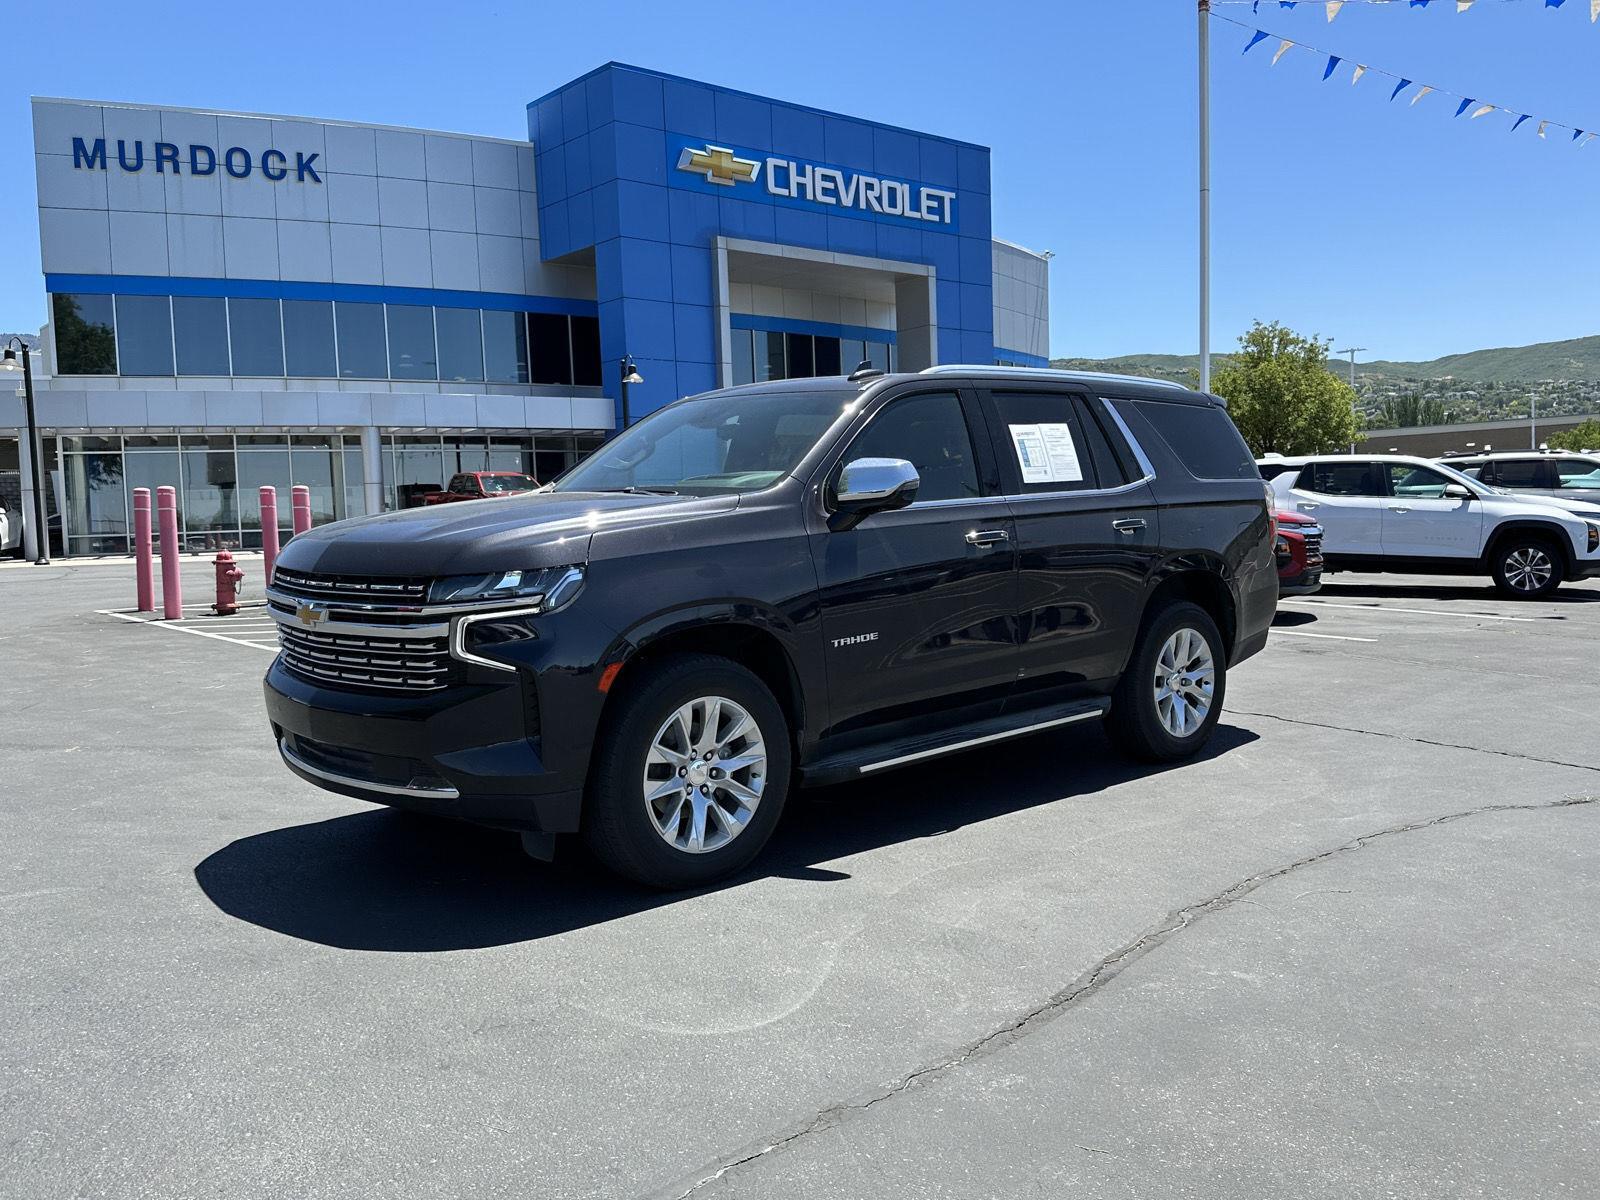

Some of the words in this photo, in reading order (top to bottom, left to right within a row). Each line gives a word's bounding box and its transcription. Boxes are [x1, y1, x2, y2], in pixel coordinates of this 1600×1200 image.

[72, 137, 323, 184] MURDOCK
[766, 157, 956, 224] CHEVROLET
[831, 631, 879, 648] TAHOE
